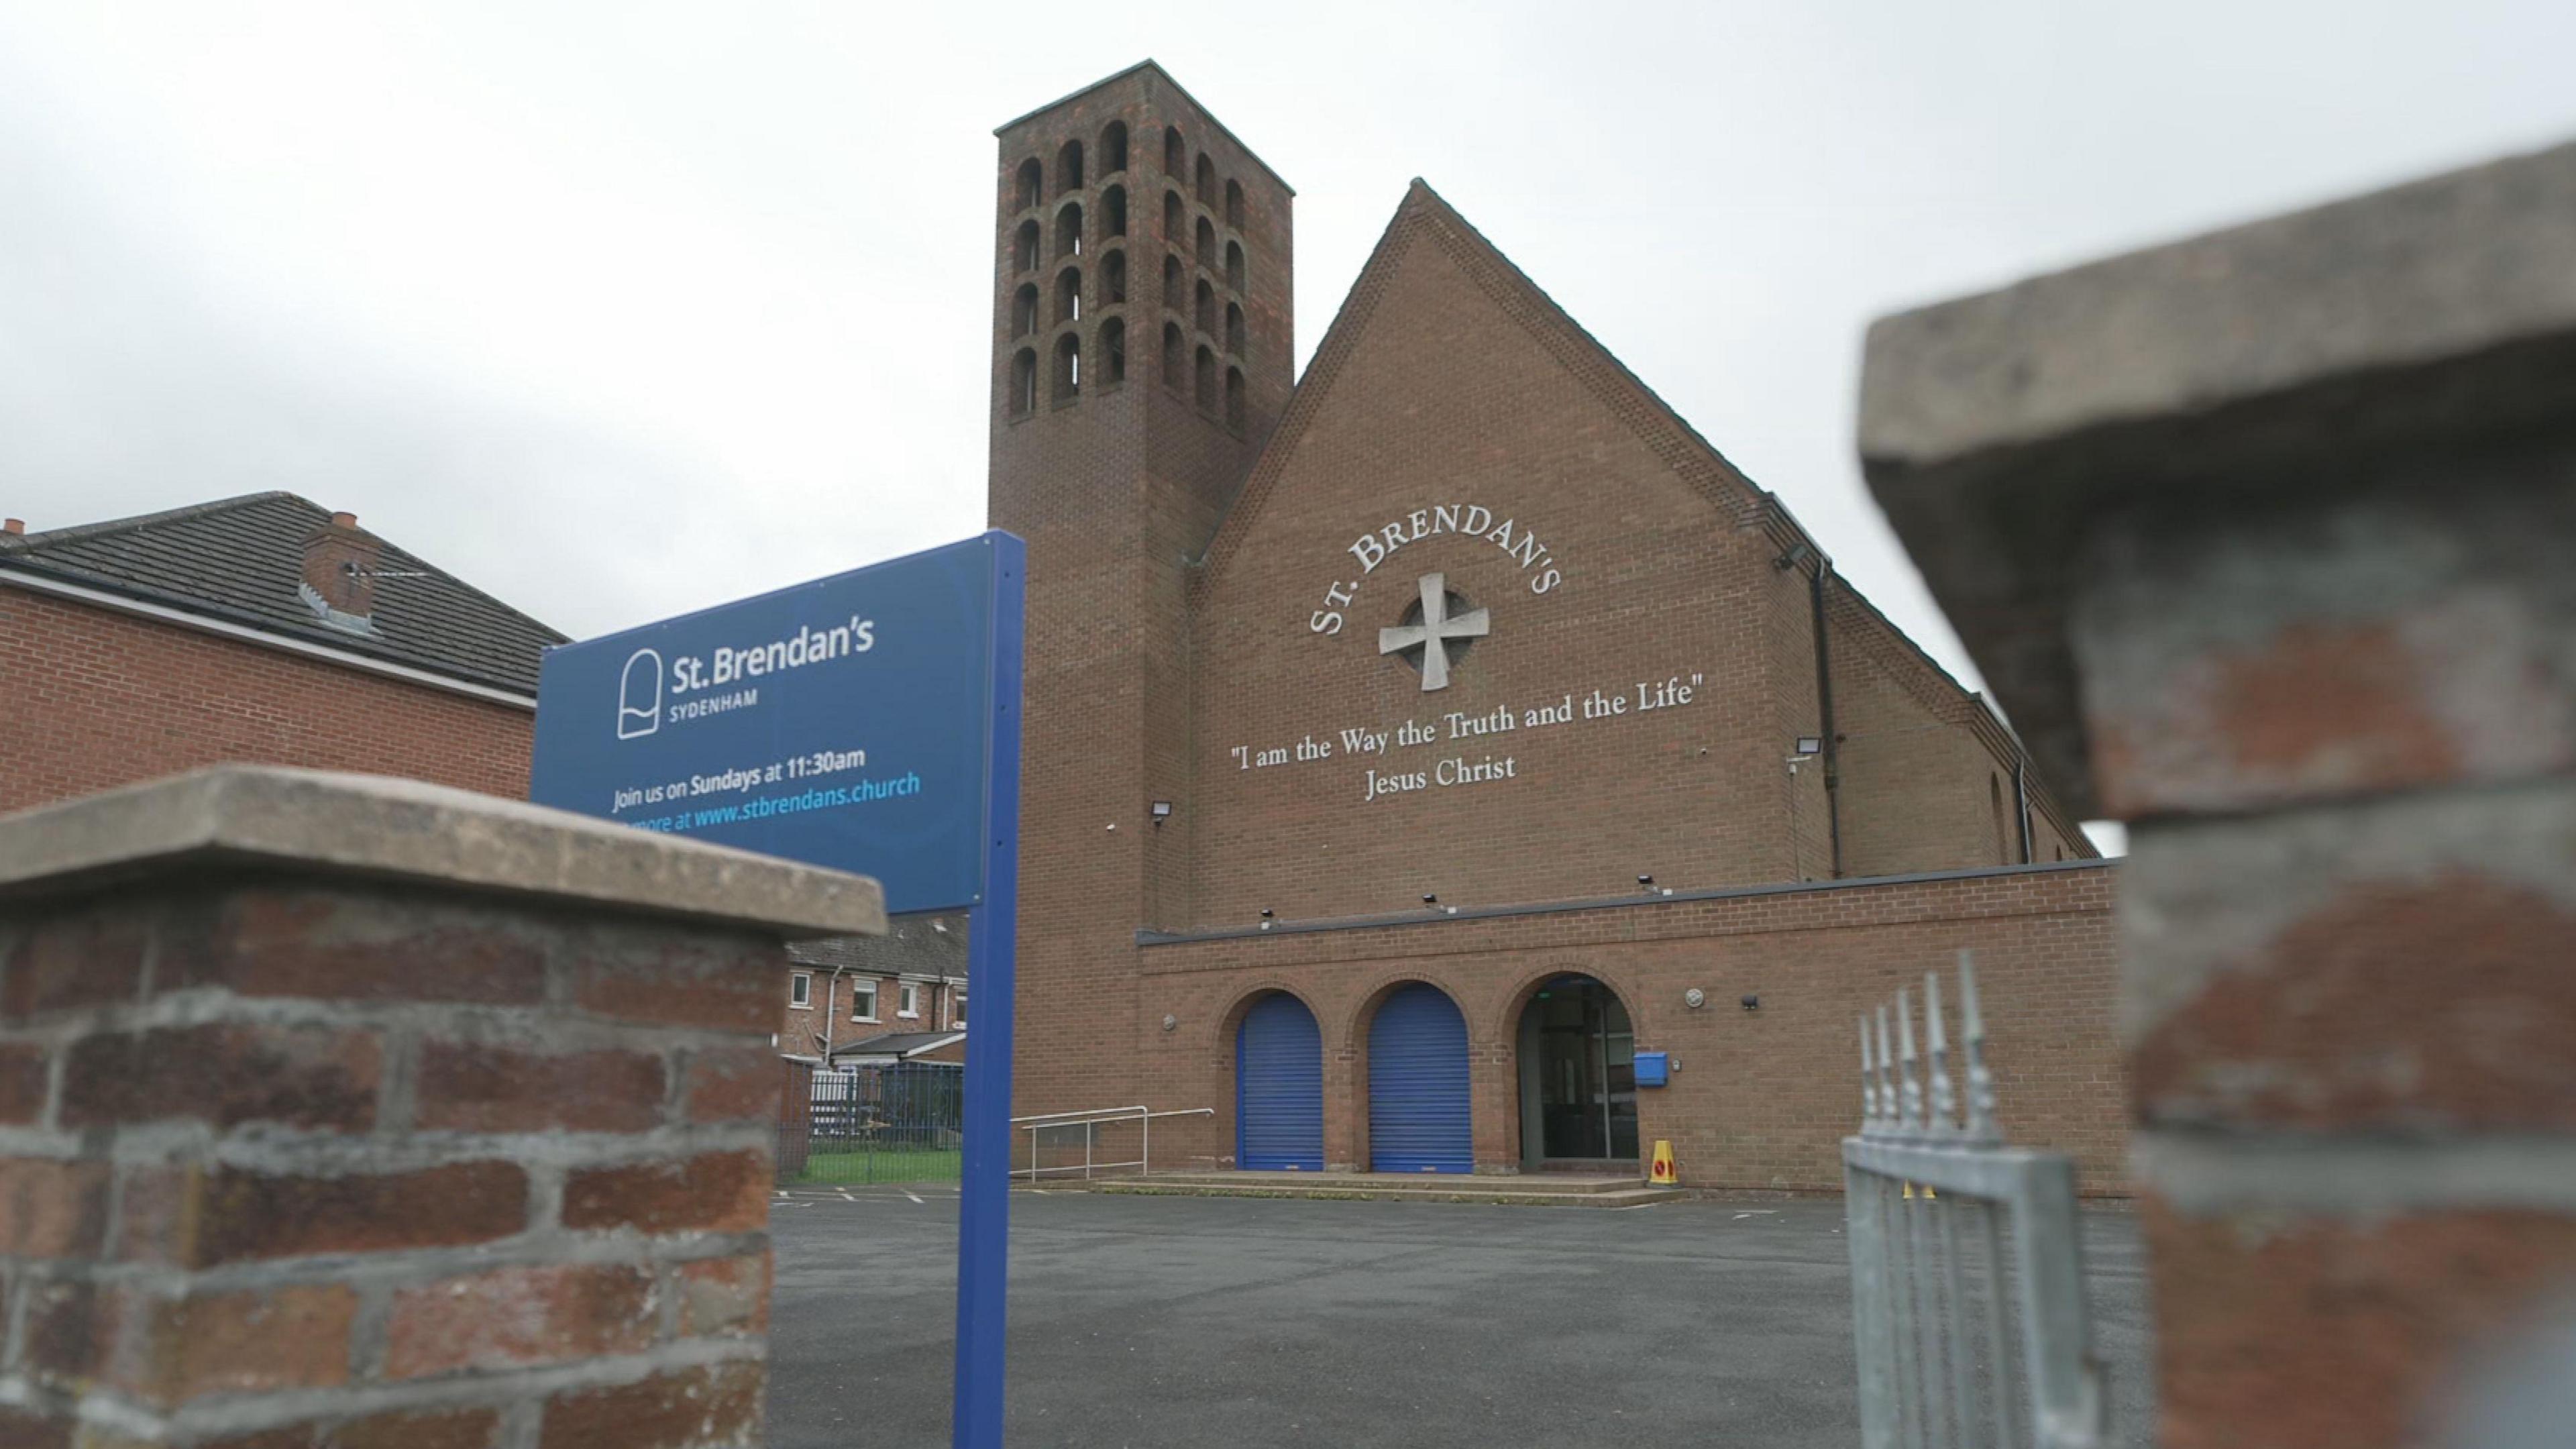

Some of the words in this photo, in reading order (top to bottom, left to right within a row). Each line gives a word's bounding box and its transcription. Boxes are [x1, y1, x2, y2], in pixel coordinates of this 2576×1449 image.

[1309, 580, 1358, 635] ST.
[1348, 504, 1562, 595] BRENDAN'S
[669, 688, 758, 723] SYDENHAM
[1231, 745, 1250, 770] "I
[1256, 748, 1288, 767] am
[1296, 734, 1332, 761] the
[1340, 727, 1389, 755] Way
[1397, 719, 1436, 747] the
[1444, 704, 1516, 739] Truth
[1525, 694, 1572, 728] and
[1582, 690, 1627, 719] the
[1636, 673, 1704, 710] Life"
[611, 786, 642, 814] Join
[645, 786, 664, 804] us
[666, 781, 687, 800] on
[690, 768, 761, 796] Sundays
[764, 763, 782, 782] at
[787, 749, 865, 779] 11:30am
[675, 810, 692, 830] at
[695, 771, 921, 827] www.stbrendans.church
[1365, 769, 1428, 802] Jesus
[1436, 754, 1516, 786] Christ
